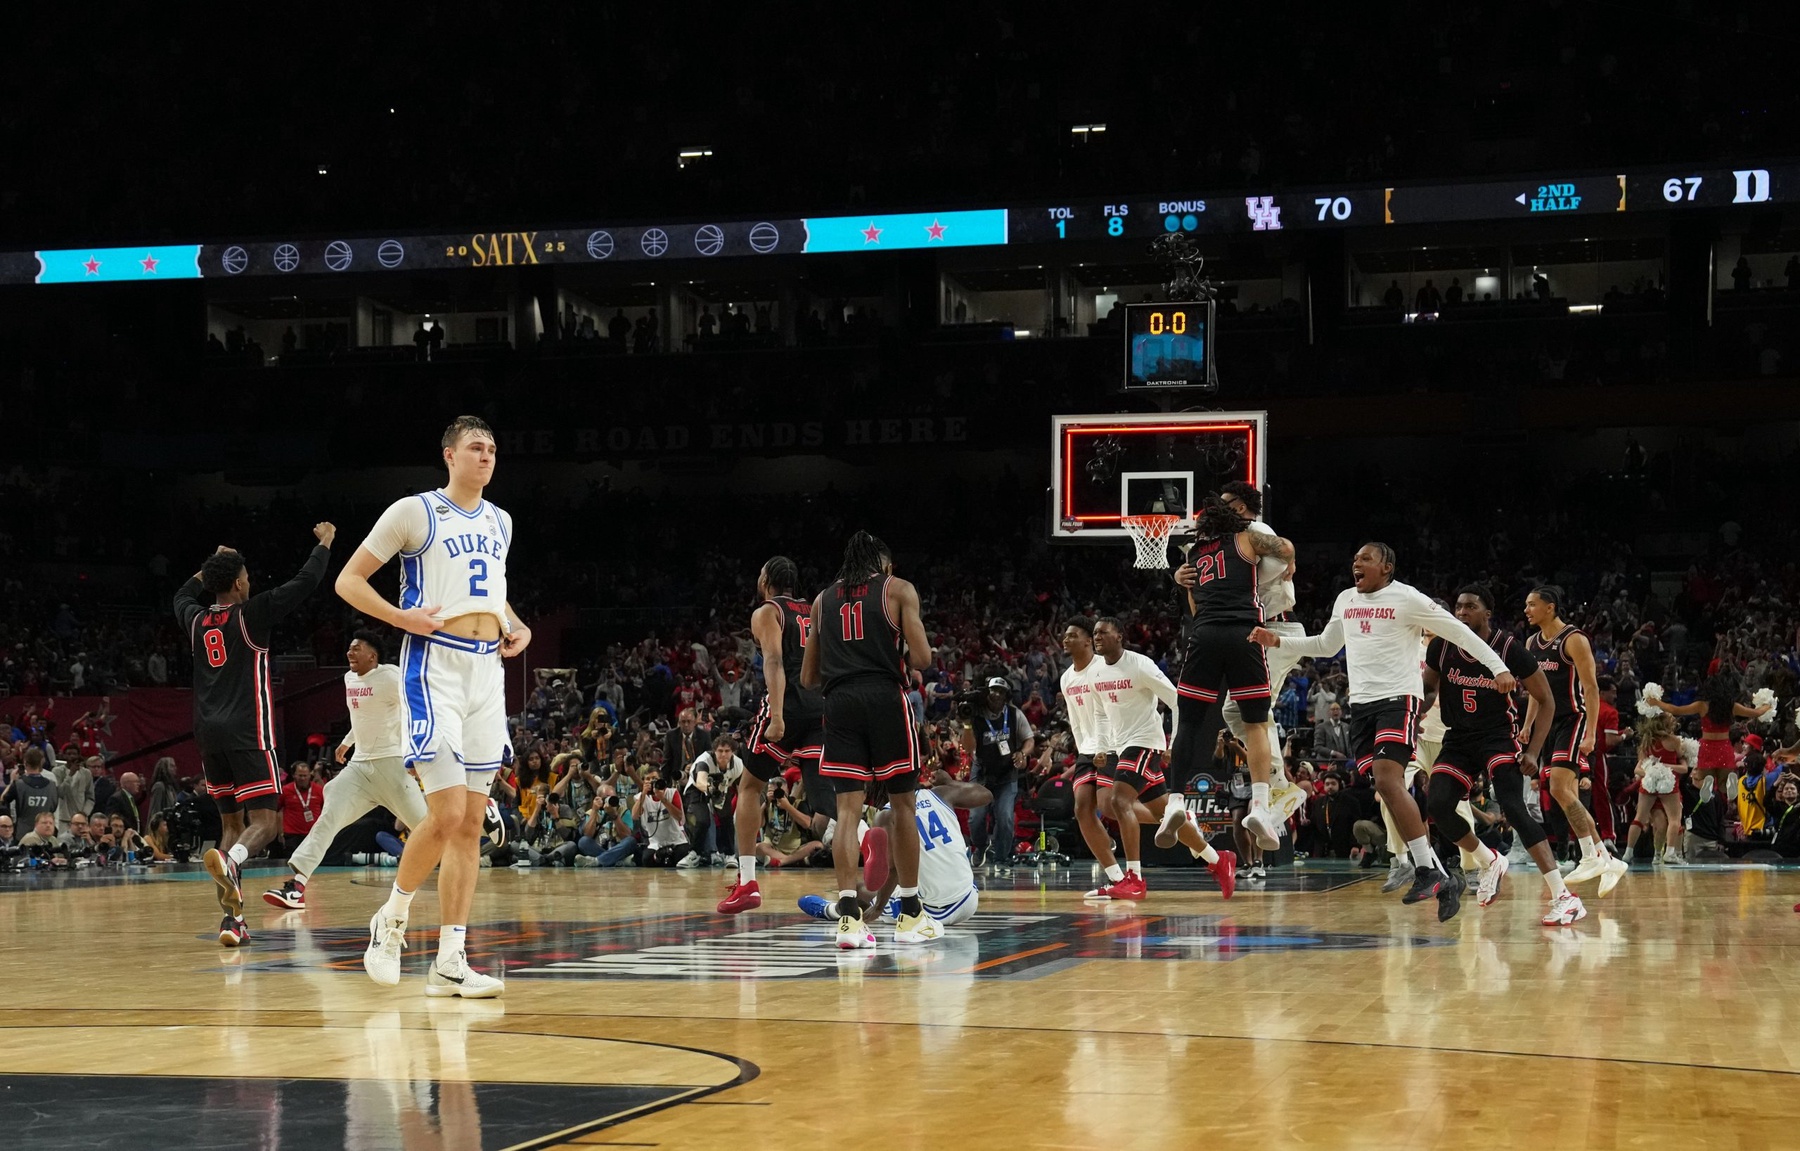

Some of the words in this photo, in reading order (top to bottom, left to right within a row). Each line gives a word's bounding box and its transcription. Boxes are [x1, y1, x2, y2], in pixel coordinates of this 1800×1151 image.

[1537, 183, 1575, 197] 2ND
[1662, 177, 1702, 202] 67
[1048, 207, 1074, 219] TOL
[1104, 204, 1128, 216] FLS
[1159, 200, 1206, 214] BONUS
[1315, 197, 1351, 221] 70
[1530, 196, 1582, 212] HALF
[1055, 219, 1066, 239] 1
[1108, 216, 1124, 236] 8
[472, 232, 539, 266] SATX
[1150, 312, 1186, 335] 0.0
[500, 429, 554, 455] HE
[576, 424, 690, 453] ROAD
[710, 420, 825, 449] ENDS
[844, 416, 970, 445] HERE
[443, 534, 502, 561] DUKE
[469, 559, 488, 597] 2
[1196, 550, 1226, 586] 21
[840, 601, 864, 641] 11
[1344, 608, 1374, 620] NOTHING
[1375, 608, 1396, 620] EASY.
[203, 628, 228, 668] 8
[1463, 689, 1477, 713] 5
[28, 796, 48, 807] 677
[915, 810, 953, 851] 14
